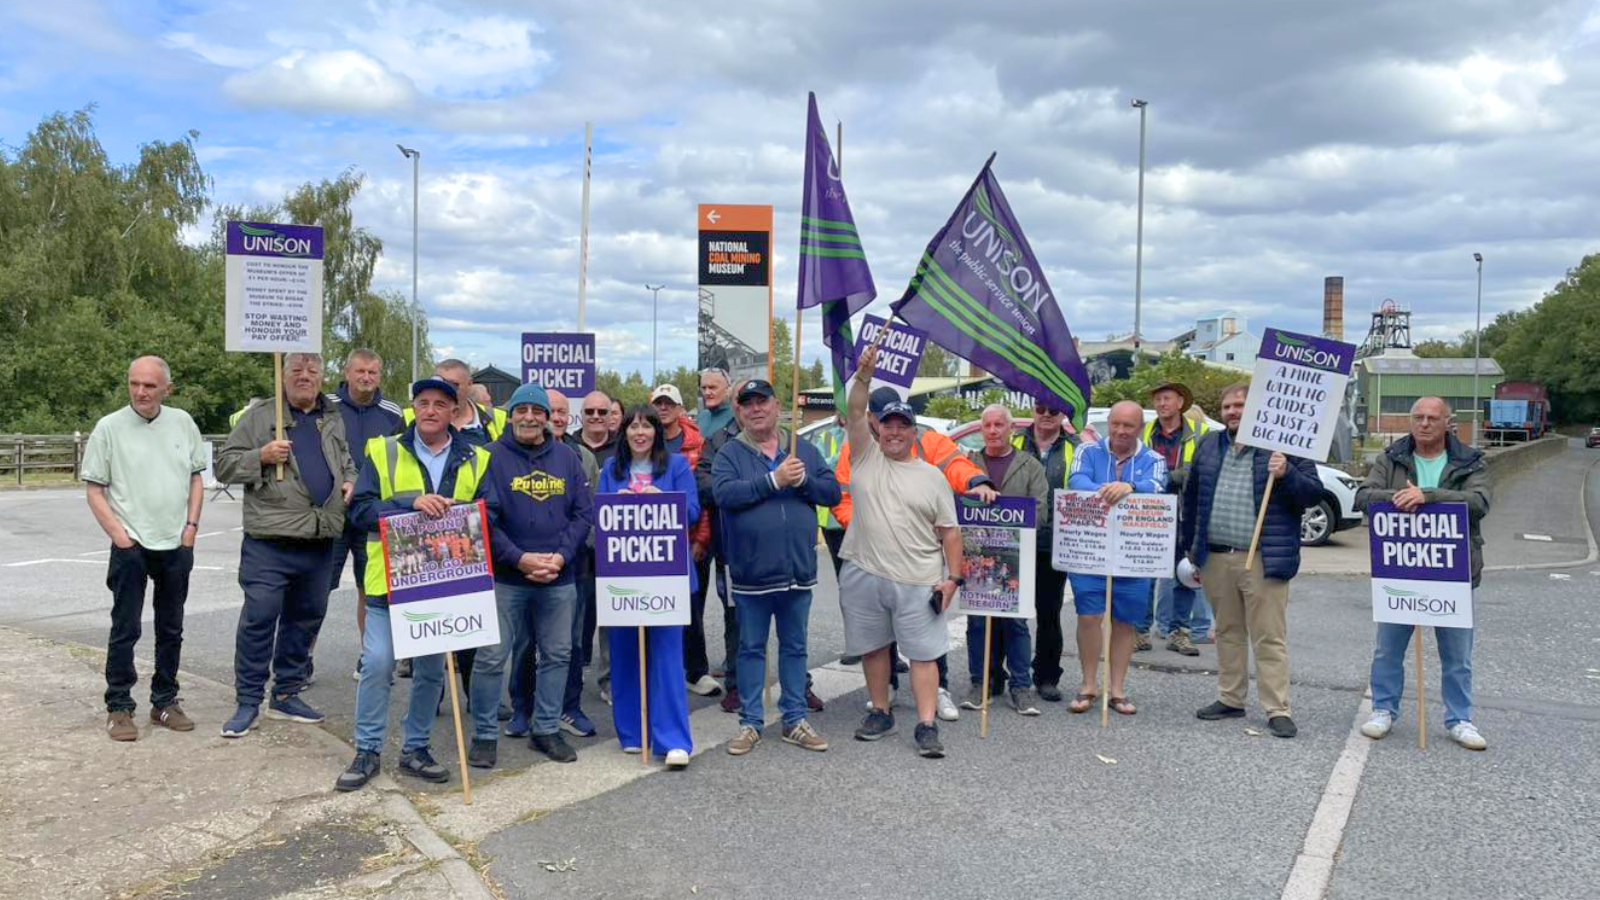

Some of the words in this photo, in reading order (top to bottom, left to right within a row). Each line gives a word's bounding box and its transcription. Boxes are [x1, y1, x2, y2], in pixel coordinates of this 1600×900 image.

[244, 235, 312, 254] UNISON
[709, 241, 749, 253] NATIONAL
[709, 252, 730, 264] COAL
[731, 253, 761, 264] MINING
[962, 211, 1049, 313] UNISON
[709, 264, 745, 275] MUSEUM
[949, 240, 963, 256] the
[959, 252, 986, 281] public
[984, 278, 1014, 310] service
[1011, 305, 1036, 335] union
[245, 313, 267, 321] STOP
[269, 313, 308, 323] WASTING
[251, 320, 281, 328] MONEY
[284, 321, 302, 329] AND
[245, 327, 281, 335] HONOUR
[284, 328, 308, 337] YOUR
[252, 334, 268, 342] PAY
[523, 343, 595, 364] OFFICIAL
[1274, 343, 1341, 368] UNISON
[528, 368, 586, 388] PICKET
[1275, 366, 1287, 378] A
[1290, 367, 1326, 385] MINE
[1265, 380, 1301, 398] WITH
[1305, 387, 1327, 402] NO
[1267, 397, 1316, 417] GUIDES
[1256, 410, 1269, 424] IS
[1272, 413, 1306, 432] JUST
[1308, 421, 1320, 435] A
[1252, 425, 1275, 441] BIG
[1278, 431, 1318, 449] HOLE
[392, 514, 420, 530] NOT
[600, 504, 683, 531] OFFICIAL
[964, 507, 1025, 523] UNISON
[1135, 515, 1174, 523] ENGLAND
[403, 525, 416, 537] A
[419, 516, 467, 534] POUND
[1059, 528, 1082, 537] Hourly
[1084, 530, 1107, 538] Wages
[1122, 521, 1168, 529] WAKEFIELD
[1373, 512, 1464, 539] OFFICIAL
[1119, 531, 1143, 539] Hourly
[608, 535, 677, 563] PICKET
[1383, 541, 1457, 568] PICKET
[421, 562, 439, 575] TO
[442, 557, 462, 571] GO
[612, 595, 676, 611] UNISON
[960, 591, 1006, 602] NOTHING
[1006, 594, 1019, 603] IN
[968, 599, 1010, 609] RETURN
[1388, 596, 1456, 613] UNISON
[410, 615, 483, 640] UNISON
